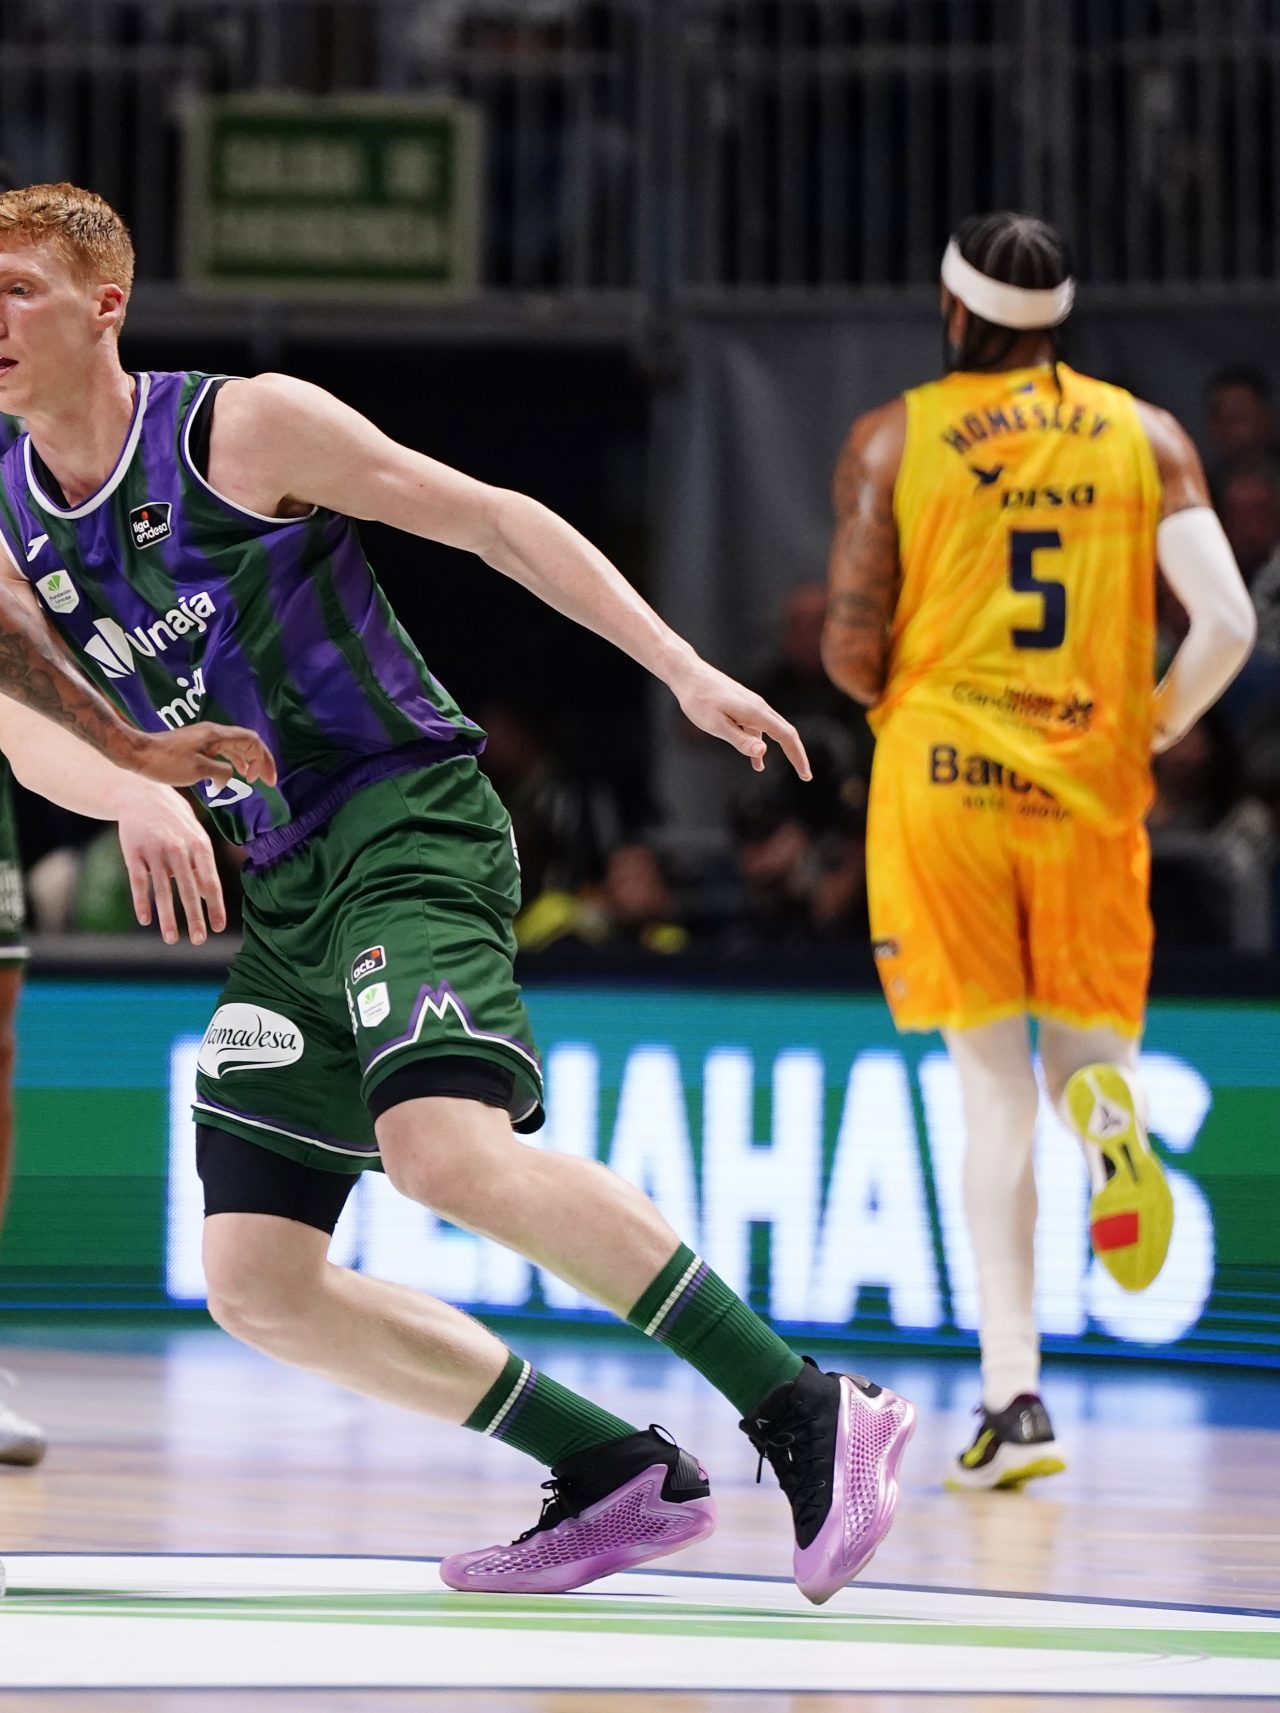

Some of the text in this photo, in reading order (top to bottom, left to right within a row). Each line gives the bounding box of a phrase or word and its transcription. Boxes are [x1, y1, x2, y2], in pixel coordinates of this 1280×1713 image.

[942, 405, 1108, 455] HOMESLEY
[133, 520, 150, 533] liga
[136, 522, 168, 543] endesa
[1008, 529, 1066, 650] 5
[353, 959, 376, 979] acb
